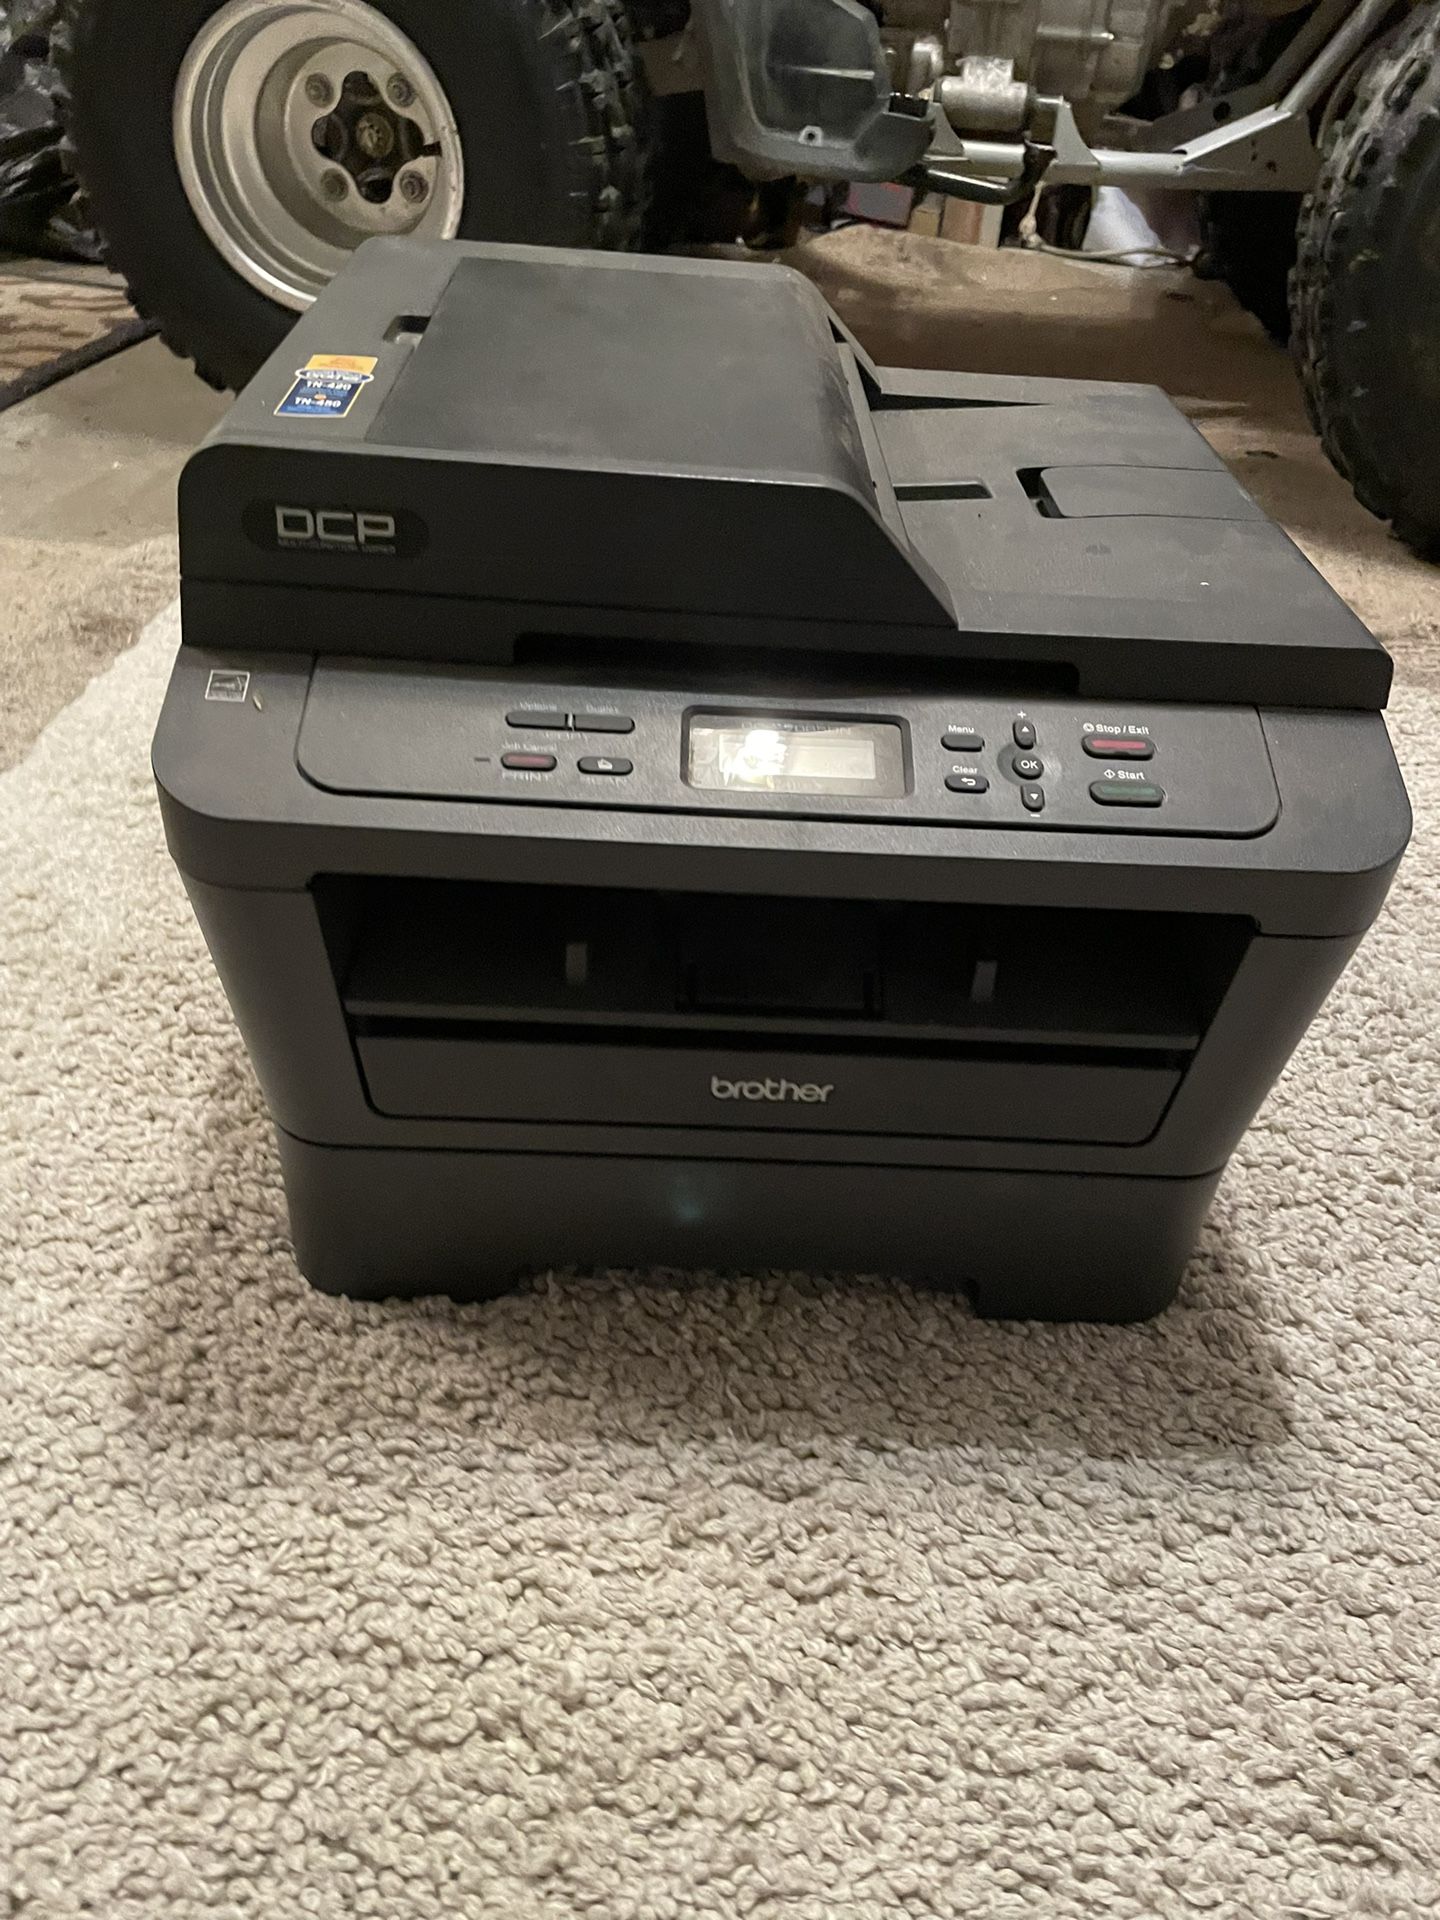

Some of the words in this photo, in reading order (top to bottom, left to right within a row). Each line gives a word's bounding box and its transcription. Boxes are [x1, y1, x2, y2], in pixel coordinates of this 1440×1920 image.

[276, 506, 395, 544] DCP
[948, 724, 975, 734] Menu
[1095, 723, 1121, 735] Stop
[1128, 724, 1150, 735] Exit
[952, 765, 978, 774] Clear
[1020, 759, 1038, 770] OK
[1117, 769, 1145, 781] Start
[711, 1075, 834, 1103] brother
